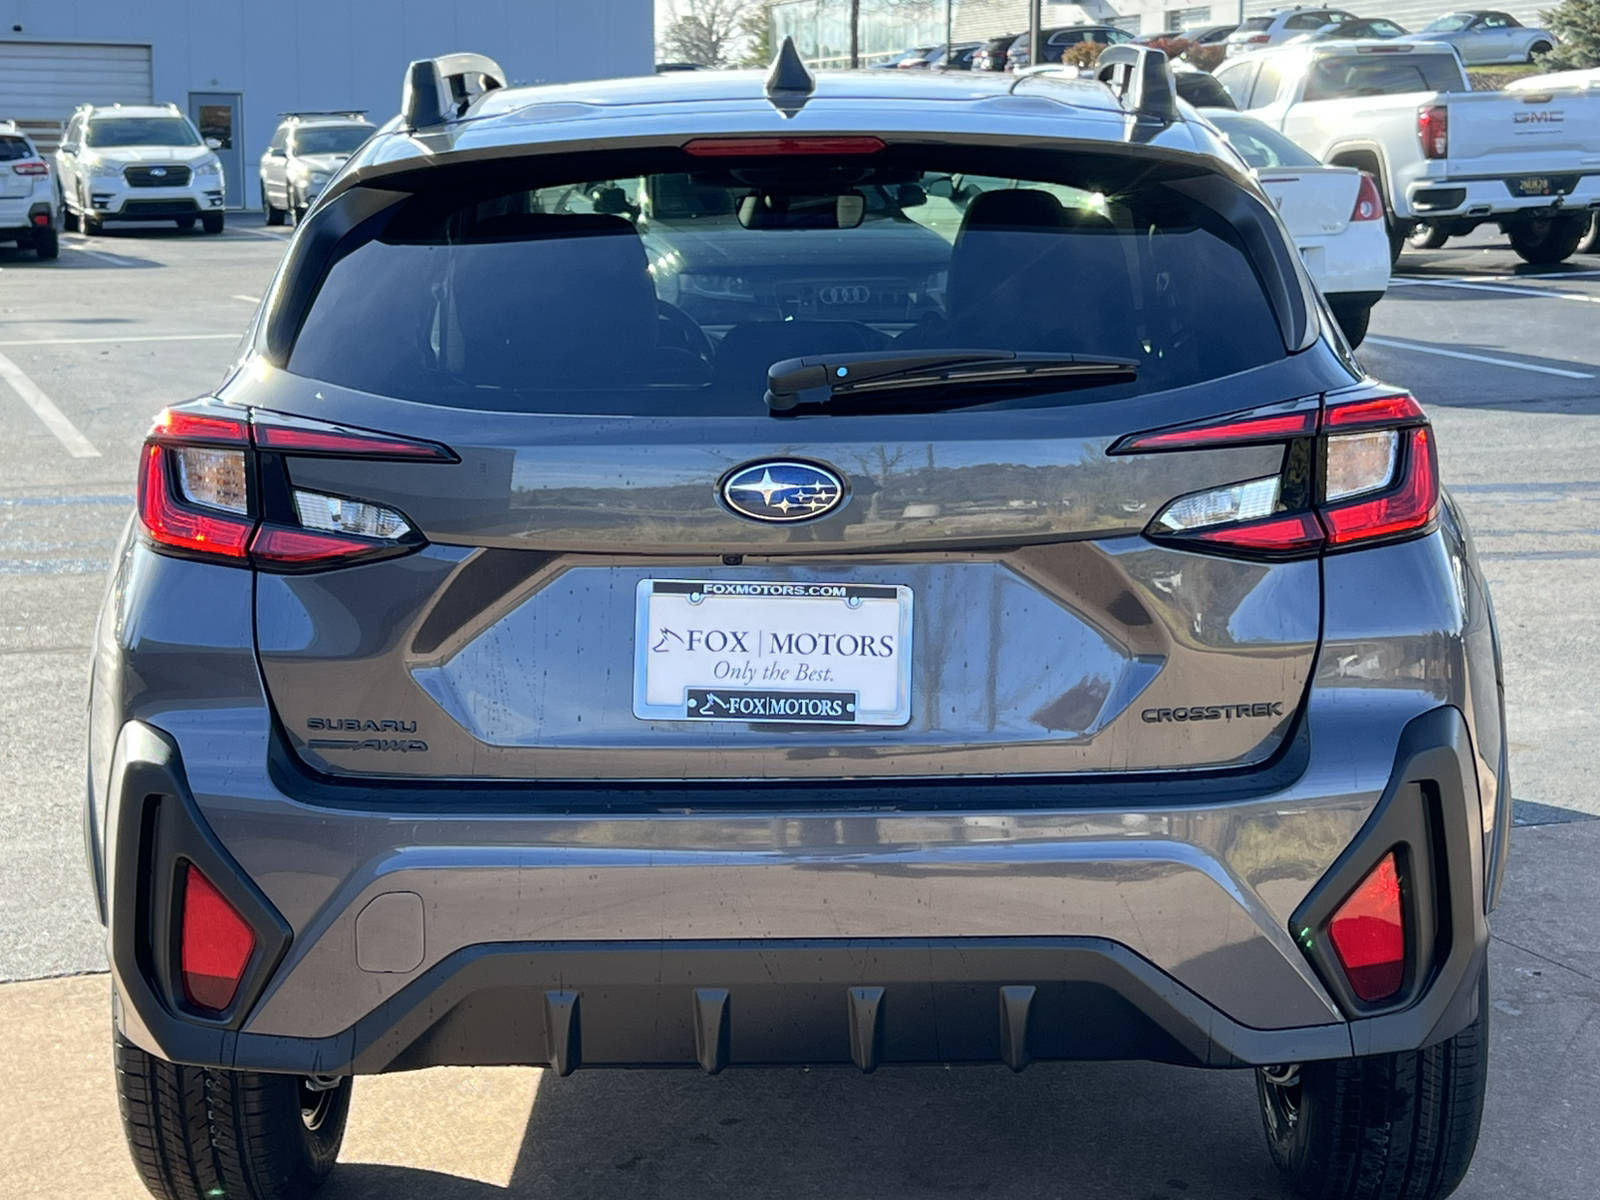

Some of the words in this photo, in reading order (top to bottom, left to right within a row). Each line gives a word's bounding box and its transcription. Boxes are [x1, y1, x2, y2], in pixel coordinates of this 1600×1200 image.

[1513, 110, 1564, 124] GMC
[703, 583, 847, 597] FOXMOTORS.COM
[686, 629, 749, 653] FOX
[769, 633, 894, 657] MOTORS
[713, 660, 757, 685] Only
[762, 661, 788, 681] the
[794, 663, 834, 682] Best.
[1141, 702, 1283, 723] CROSSTREK
[307, 717, 417, 733] SUBARU
[352, 739, 428, 752] AWD
